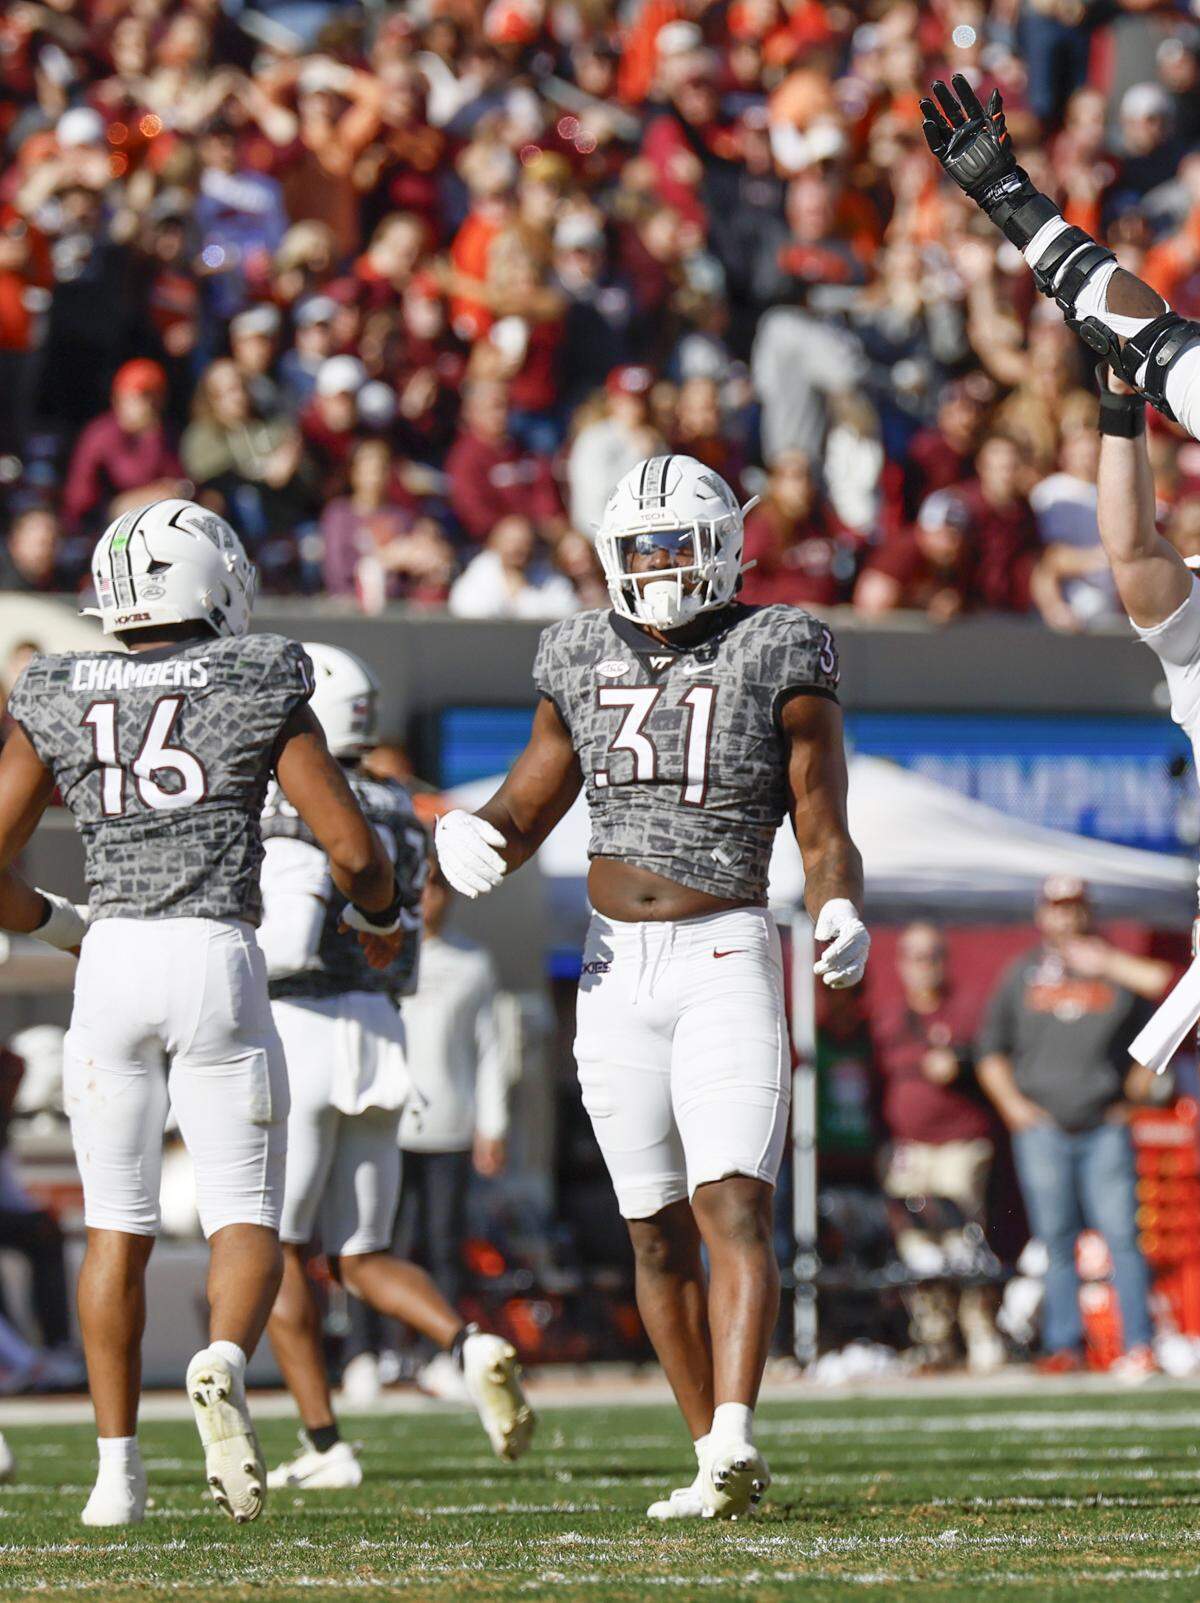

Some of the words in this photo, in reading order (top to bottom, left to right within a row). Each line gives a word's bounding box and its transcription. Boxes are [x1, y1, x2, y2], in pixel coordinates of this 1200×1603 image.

[641, 512, 665, 521] TECH
[71, 657, 209, 691] CHAMBERS
[649, 656, 674, 669] VT
[79, 694, 209, 817] 16
[593, 684, 720, 808] 31
